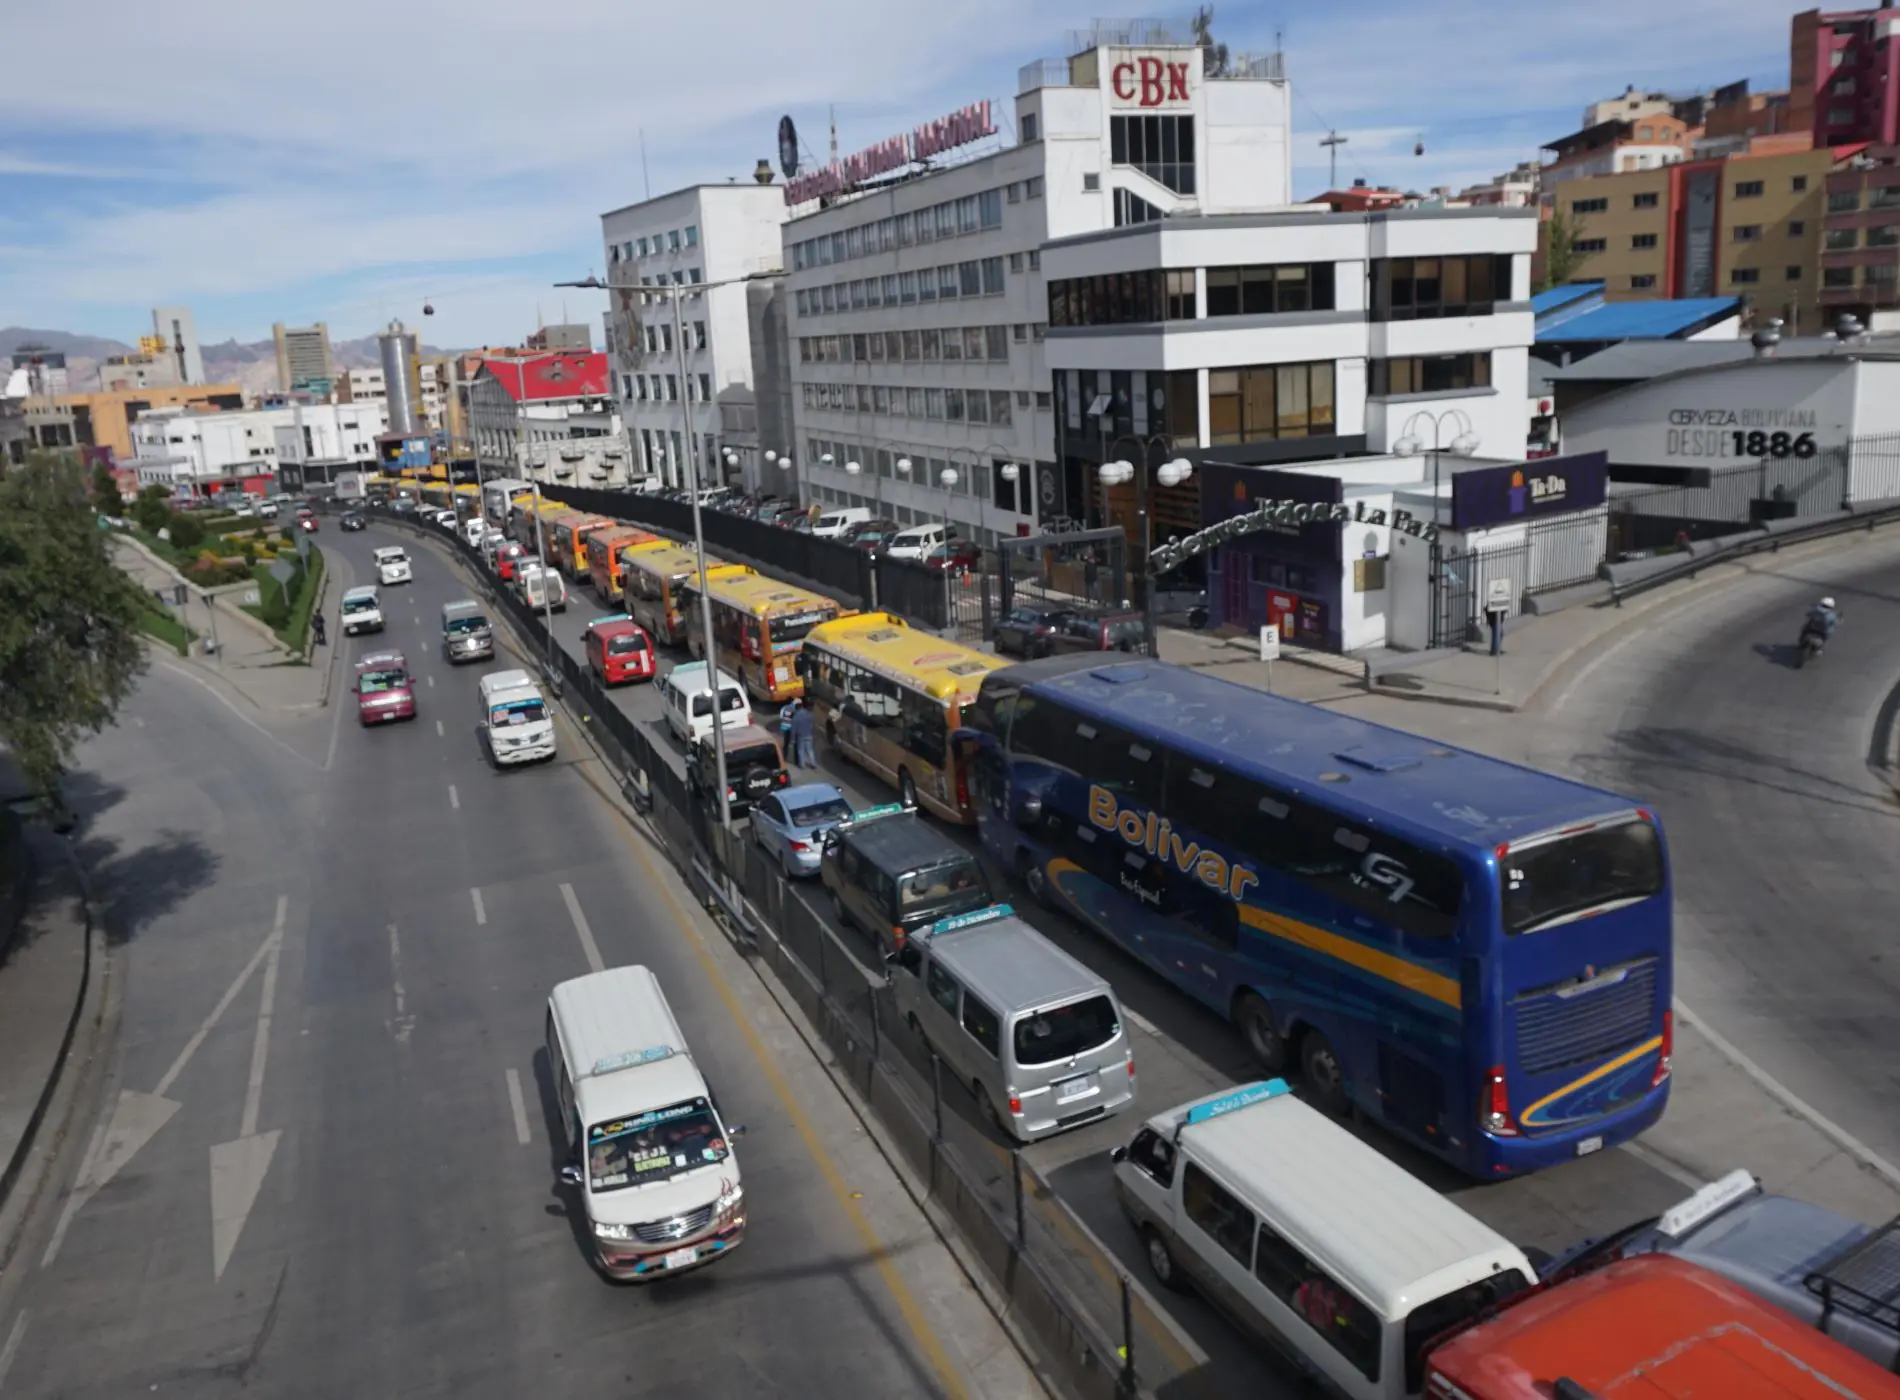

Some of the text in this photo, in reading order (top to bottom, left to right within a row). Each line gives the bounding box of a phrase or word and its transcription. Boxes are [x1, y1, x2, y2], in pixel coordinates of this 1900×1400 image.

[1112, 56, 1190, 107] CBN
[1668, 408, 1739, 426] CERVEZA
[1666, 428, 1818, 460] DESDE 1886
[1355, 500, 1387, 527] La
[1392, 508, 1441, 542] Paz
[1267, 631, 1275, 643] E
[749, 778, 771, 788] Jeep
[1089, 784, 1259, 900] Bolivar
